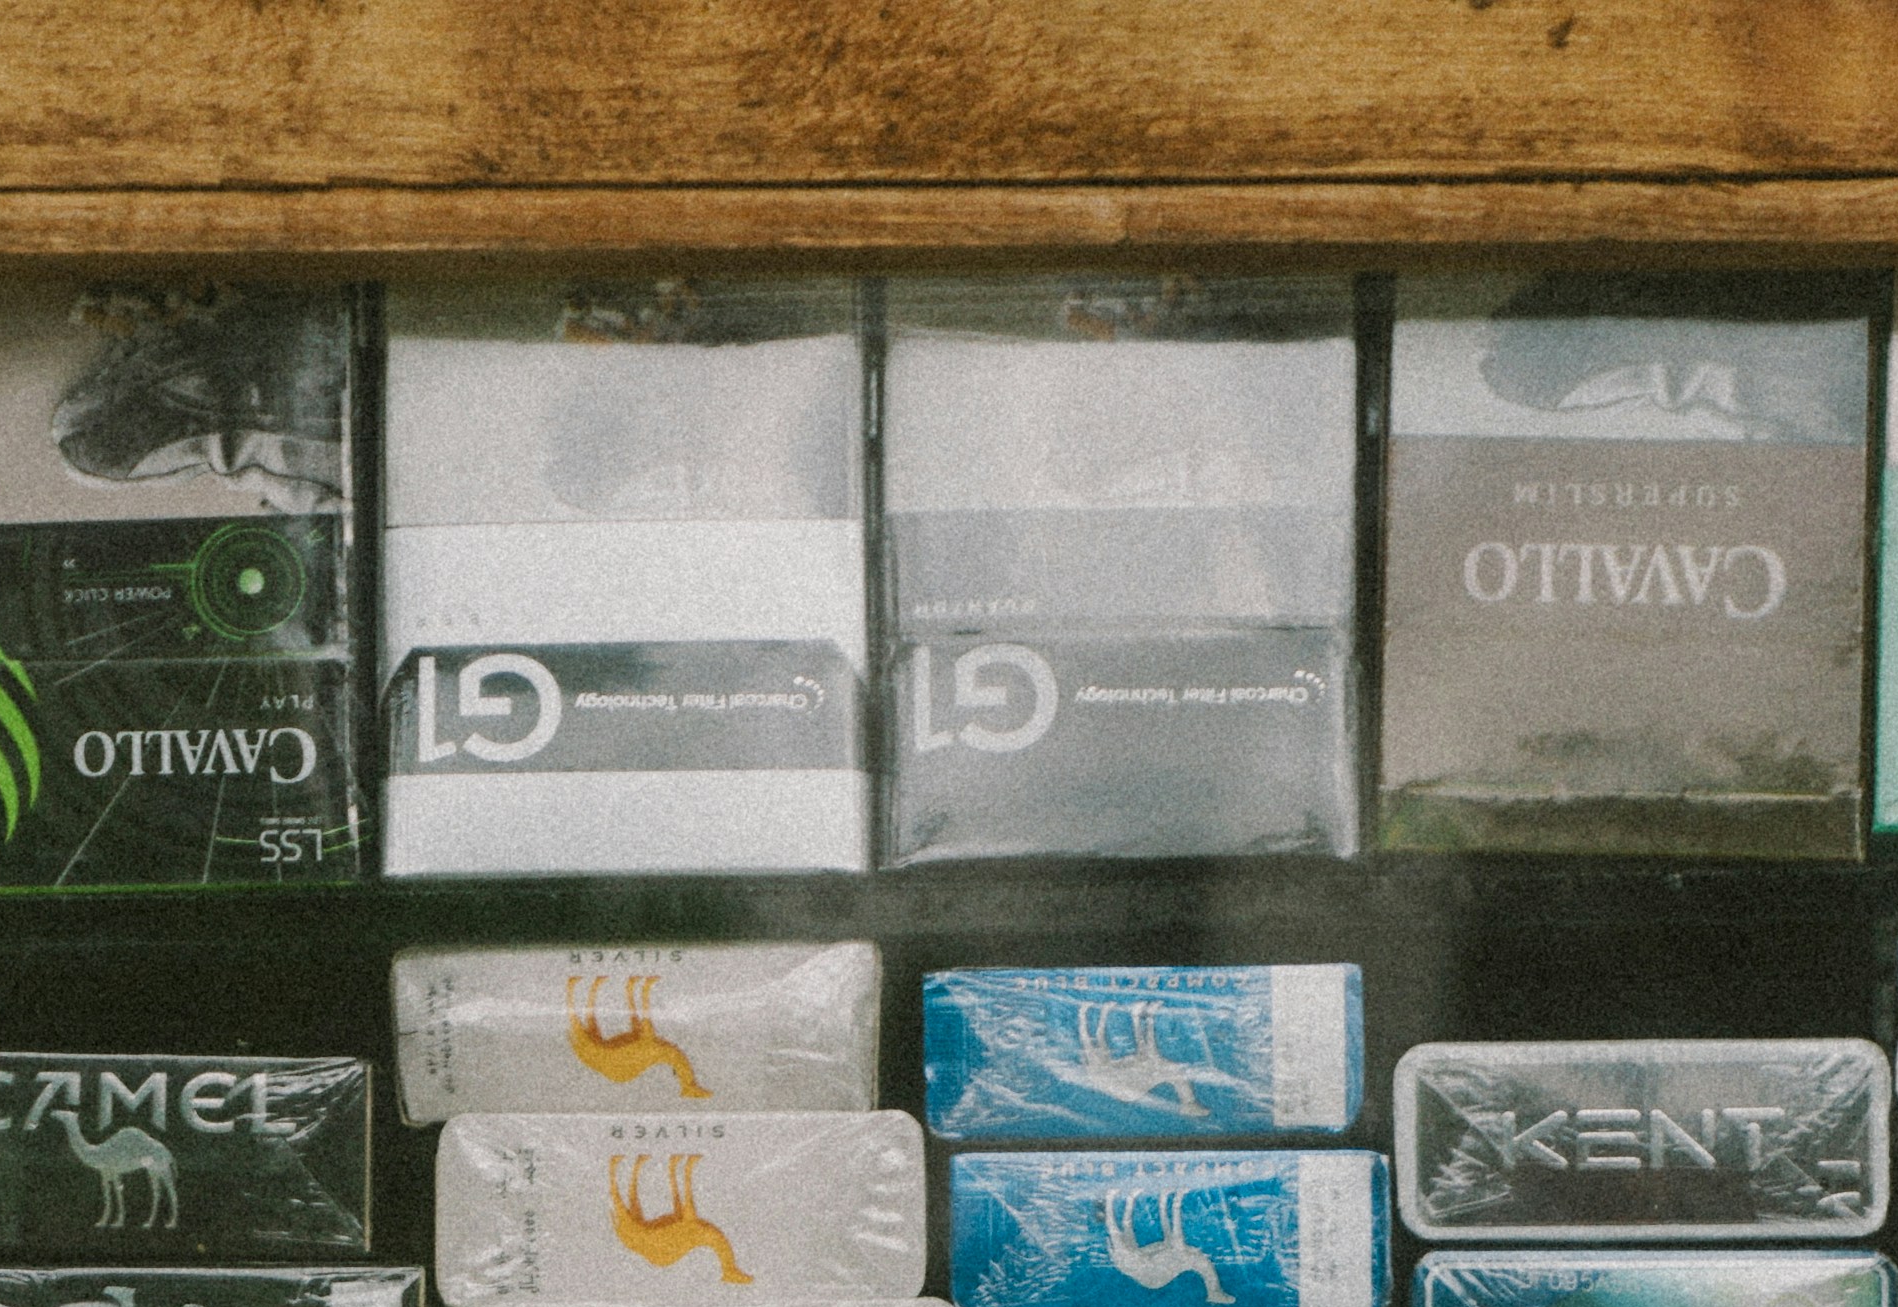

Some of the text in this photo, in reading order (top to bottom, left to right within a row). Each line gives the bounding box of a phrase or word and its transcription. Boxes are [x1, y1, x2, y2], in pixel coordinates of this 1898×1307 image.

[1513, 483, 1741, 508] SUPERSLIM
[1463, 541, 1784, 619] CAVALLO
[114, 586, 172, 601] POWER
[262, 695, 314, 709] PLAY
[575, 690, 807, 713] Charcoal Filter Technology
[914, 645, 1057, 753] G1
[1076, 686, 1308, 704] Charcoal Filter Technology
[419, 654, 562, 763] G1
[75, 729, 318, 783] CAVALLO
[261, 830, 321, 863] LSS
[568, 950, 682, 966] SILVER
[611, 1124, 725, 1140] SILVER
[1504, 1107, 1785, 1170] KENT
